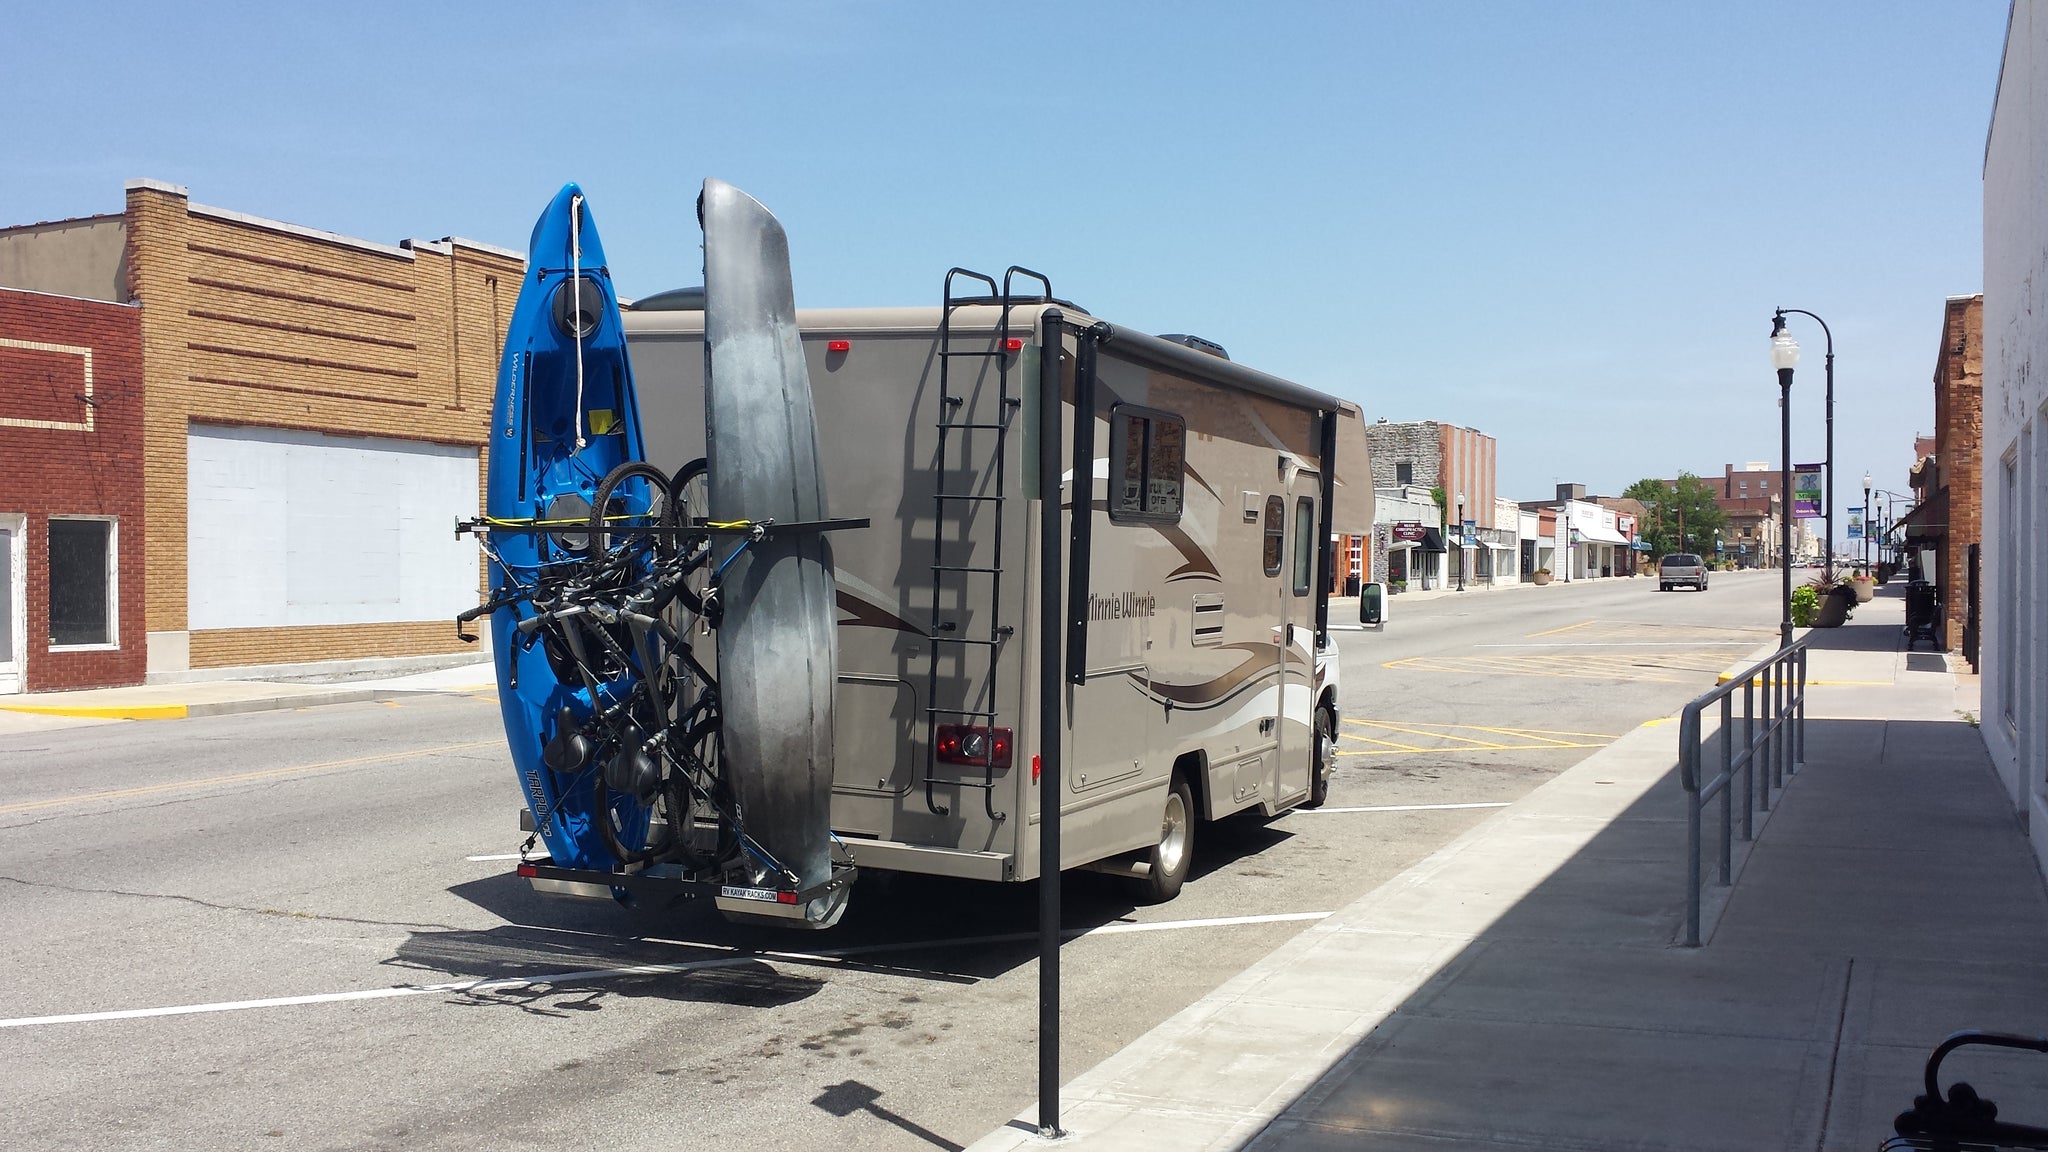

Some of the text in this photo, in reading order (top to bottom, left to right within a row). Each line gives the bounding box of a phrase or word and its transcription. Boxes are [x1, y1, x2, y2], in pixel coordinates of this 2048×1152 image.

[509, 352, 519, 426] WILDERNESS
[1122, 590, 1155, 619] Winnie
[722, 887, 777, 901] RV KAYAK RACKS.COM
